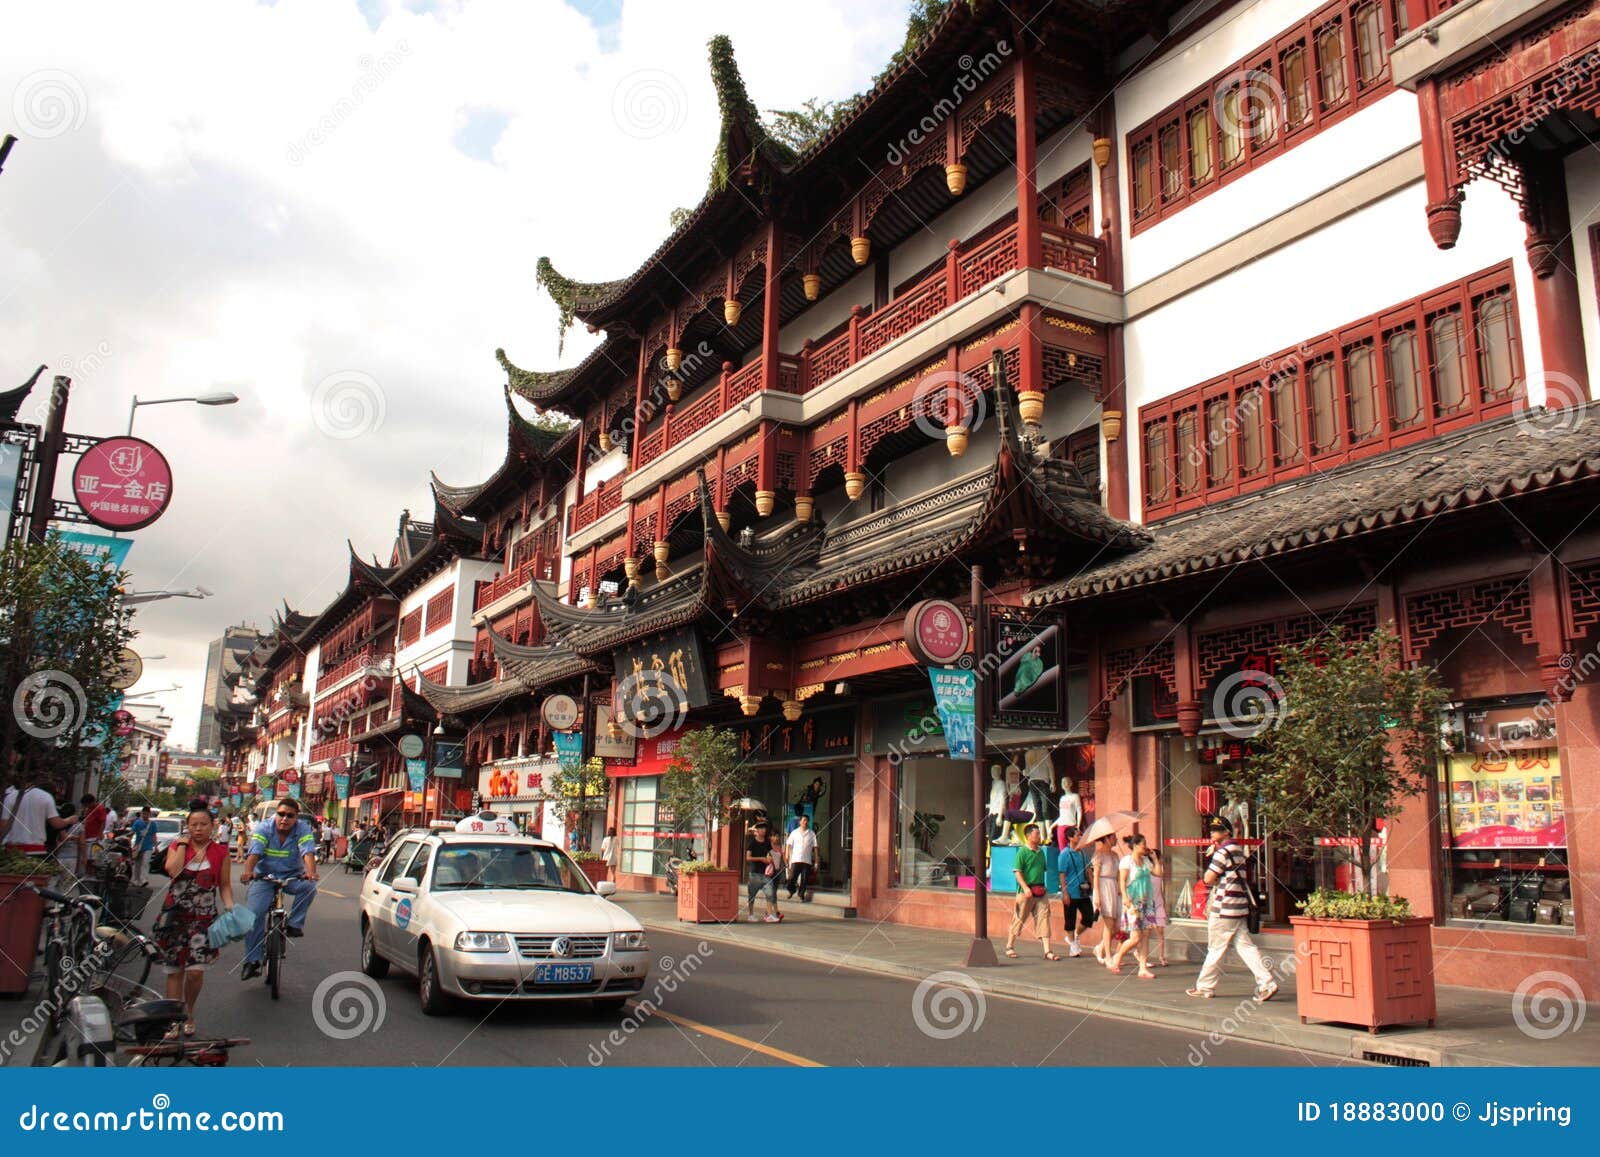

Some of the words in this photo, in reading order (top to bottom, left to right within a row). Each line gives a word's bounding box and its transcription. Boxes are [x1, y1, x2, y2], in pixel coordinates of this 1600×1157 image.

[77, 475, 167, 501] 亚一金店
[90, 501, 150, 515] 中国驰名商标
[471, 821, 508, 833] 锦江
